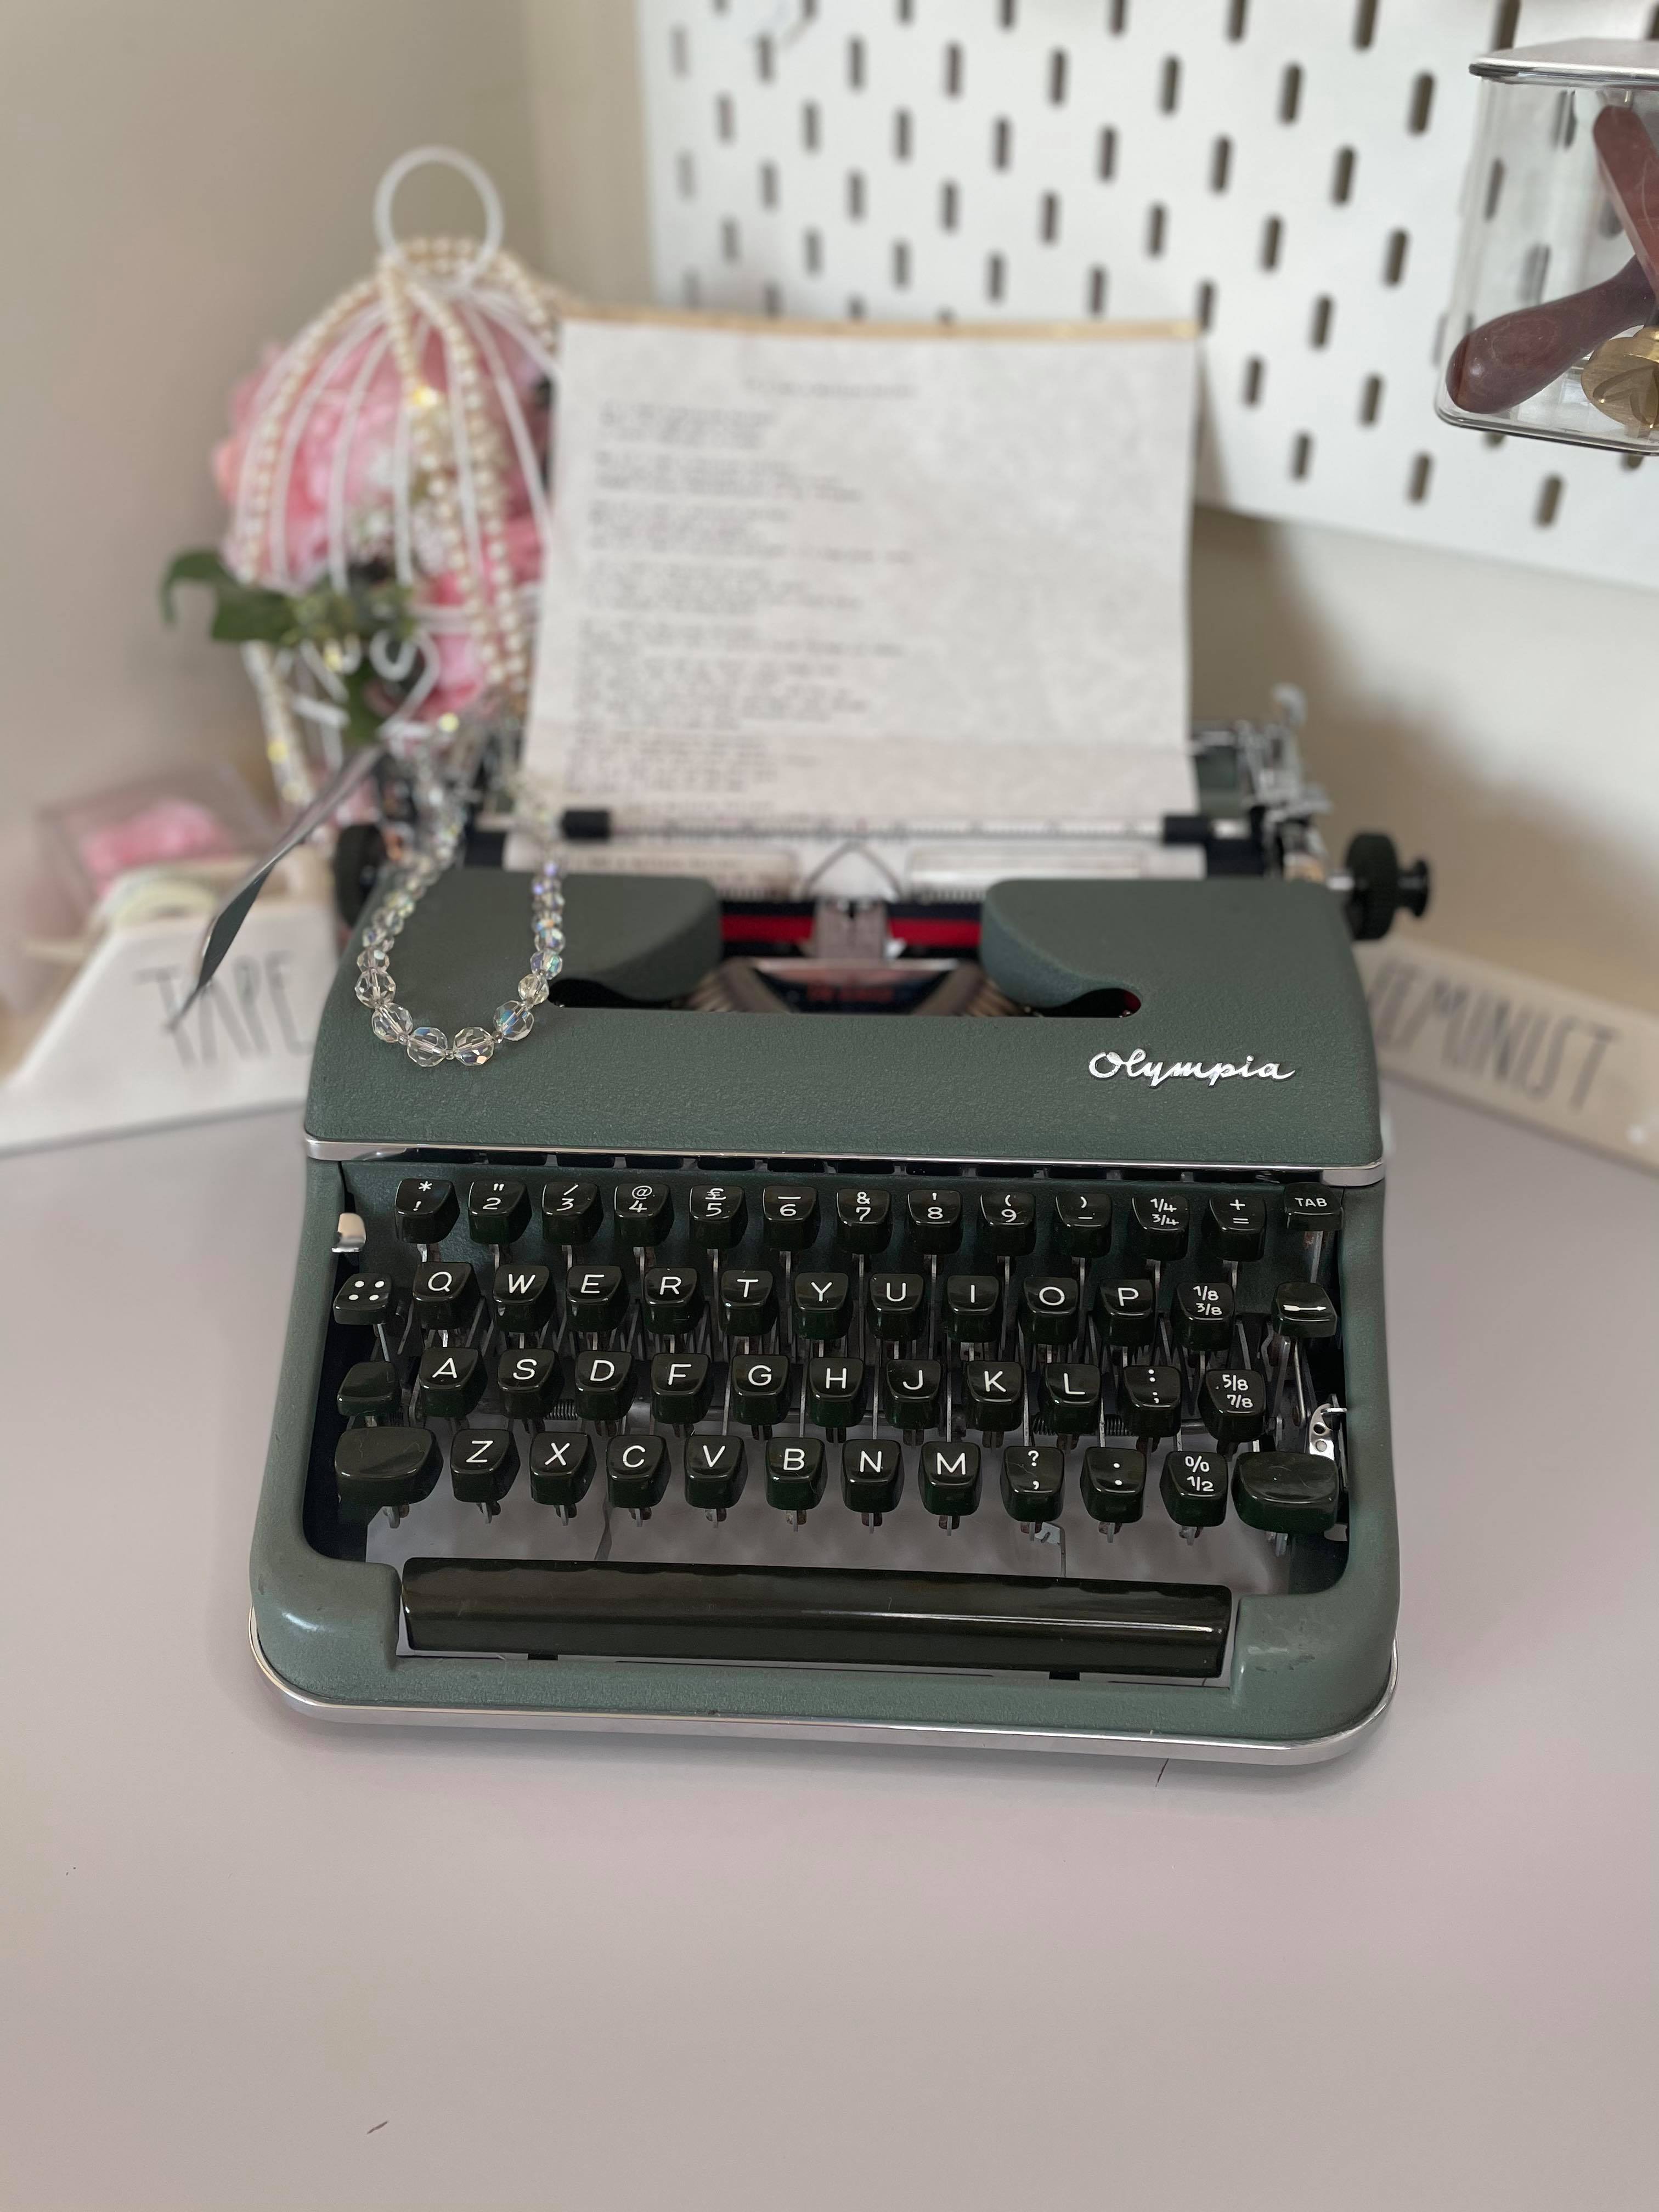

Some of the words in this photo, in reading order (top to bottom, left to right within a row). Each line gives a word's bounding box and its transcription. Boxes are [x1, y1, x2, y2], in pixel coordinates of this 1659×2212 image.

[1088, 1048, 1295, 1087] Olympia
[482, 1197, 501, 1210] 2
[556, 1198, 574, 1211] 3
[629, 1200, 647, 1213] 4
[706, 1203, 722, 1217] 5
[780, 1204, 797, 1216] 6
[856, 1207, 871, 1221] 7
[927, 1206, 943, 1220] 8
[1001, 1209, 1017, 1223] 9
[1152, 1214, 1180, 1226] 3/4
[631, 1185, 652, 1200] @
[856, 1191, 870, 1204] &
[1150, 1198, 1177, 1212] 1/4
[1294, 1198, 1327, 1207] TAB
[428, 1271, 452, 1292] Q
[508, 1273, 536, 1294] W
[580, 1274, 605, 1294] E
[659, 1276, 682, 1295] R
[737, 1279, 759, 1298] T
[811, 1282, 832, 1302] Y
[886, 1282, 906, 1302] U
[970, 1284, 975, 1303] I
[1039, 1286, 1065, 1306] O
[1118, 1287, 1139, 1306] P
[1193, 1285, 1219, 1301] 1/8
[1195, 1302, 1222, 1316] 3/8
[432, 1357, 458, 1379] A
[512, 1358, 537, 1380] S
[590, 1359, 615, 1381] D
[668, 1363, 692, 1385] F
[748, 1365, 772, 1386] G
[826, 1368, 847, 1389] H
[902, 1369, 923, 1390] J
[984, 1370, 1006, 1392] K
[1064, 1373, 1086, 1395] L
[1222, 1374, 1249, 1391] 5/8
[1227, 1394, 1253, 1408] 7/8
[466, 1440, 493, 1463] Z
[544, 1442, 570, 1466] X
[623, 1445, 646, 1468] C
[703, 1445, 726, 1468] V
[783, 1448, 805, 1470] B
[860, 1451, 882, 1473] N
[936, 1452, 966, 1475] M
[1028, 1450, 1039, 1466] ?
[1187, 1476, 1214, 1492] 1/2
